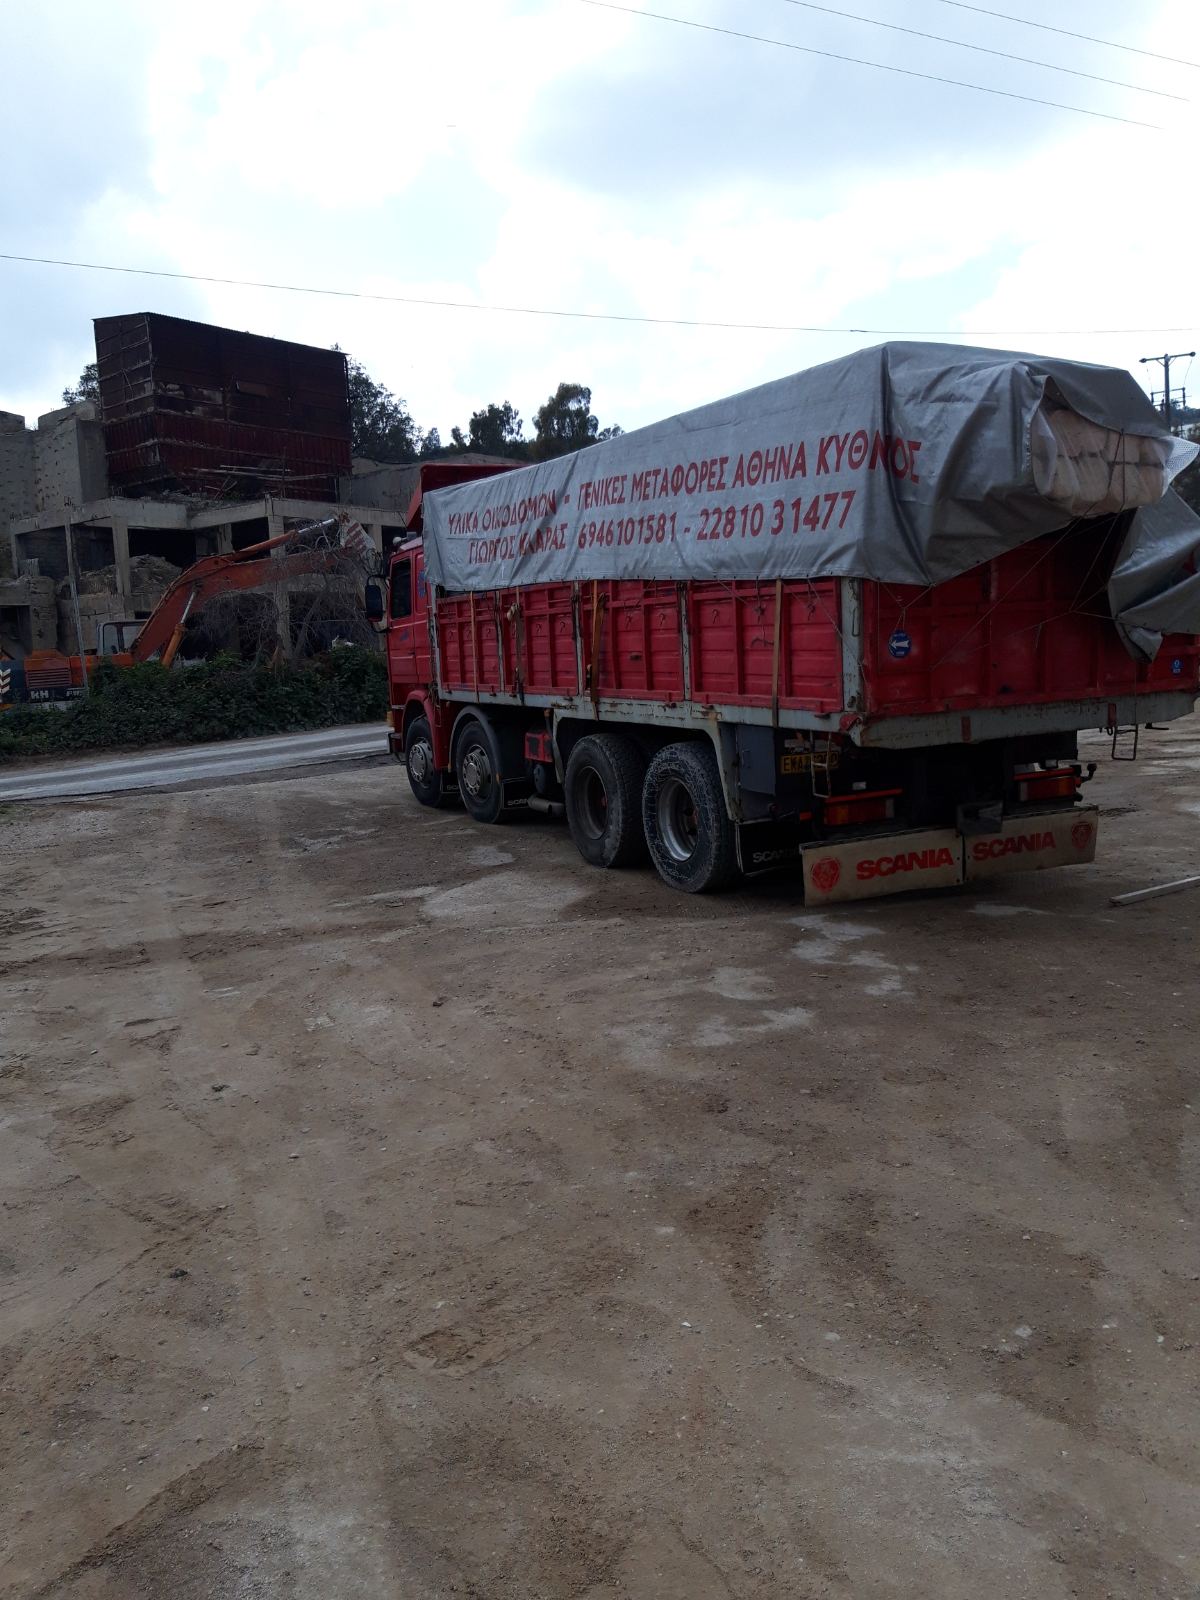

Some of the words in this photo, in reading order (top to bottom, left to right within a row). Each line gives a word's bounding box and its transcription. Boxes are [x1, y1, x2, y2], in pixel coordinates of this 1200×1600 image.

[577, 474, 627, 511] ΓΕΝΙΚΕΣ
[631, 455, 729, 503] ΜΕΤΑΦΟΡΕΣ
[731, 441, 807, 489] ΑΘΗΝΑ
[577, 512, 677, 549] 6946101581
[696, 502, 764, 541] 22810
[770, 489, 857, 535] 31477
[856, 847, 954, 881] SCANIA
[971, 831, 1057, 863] SCANIA
